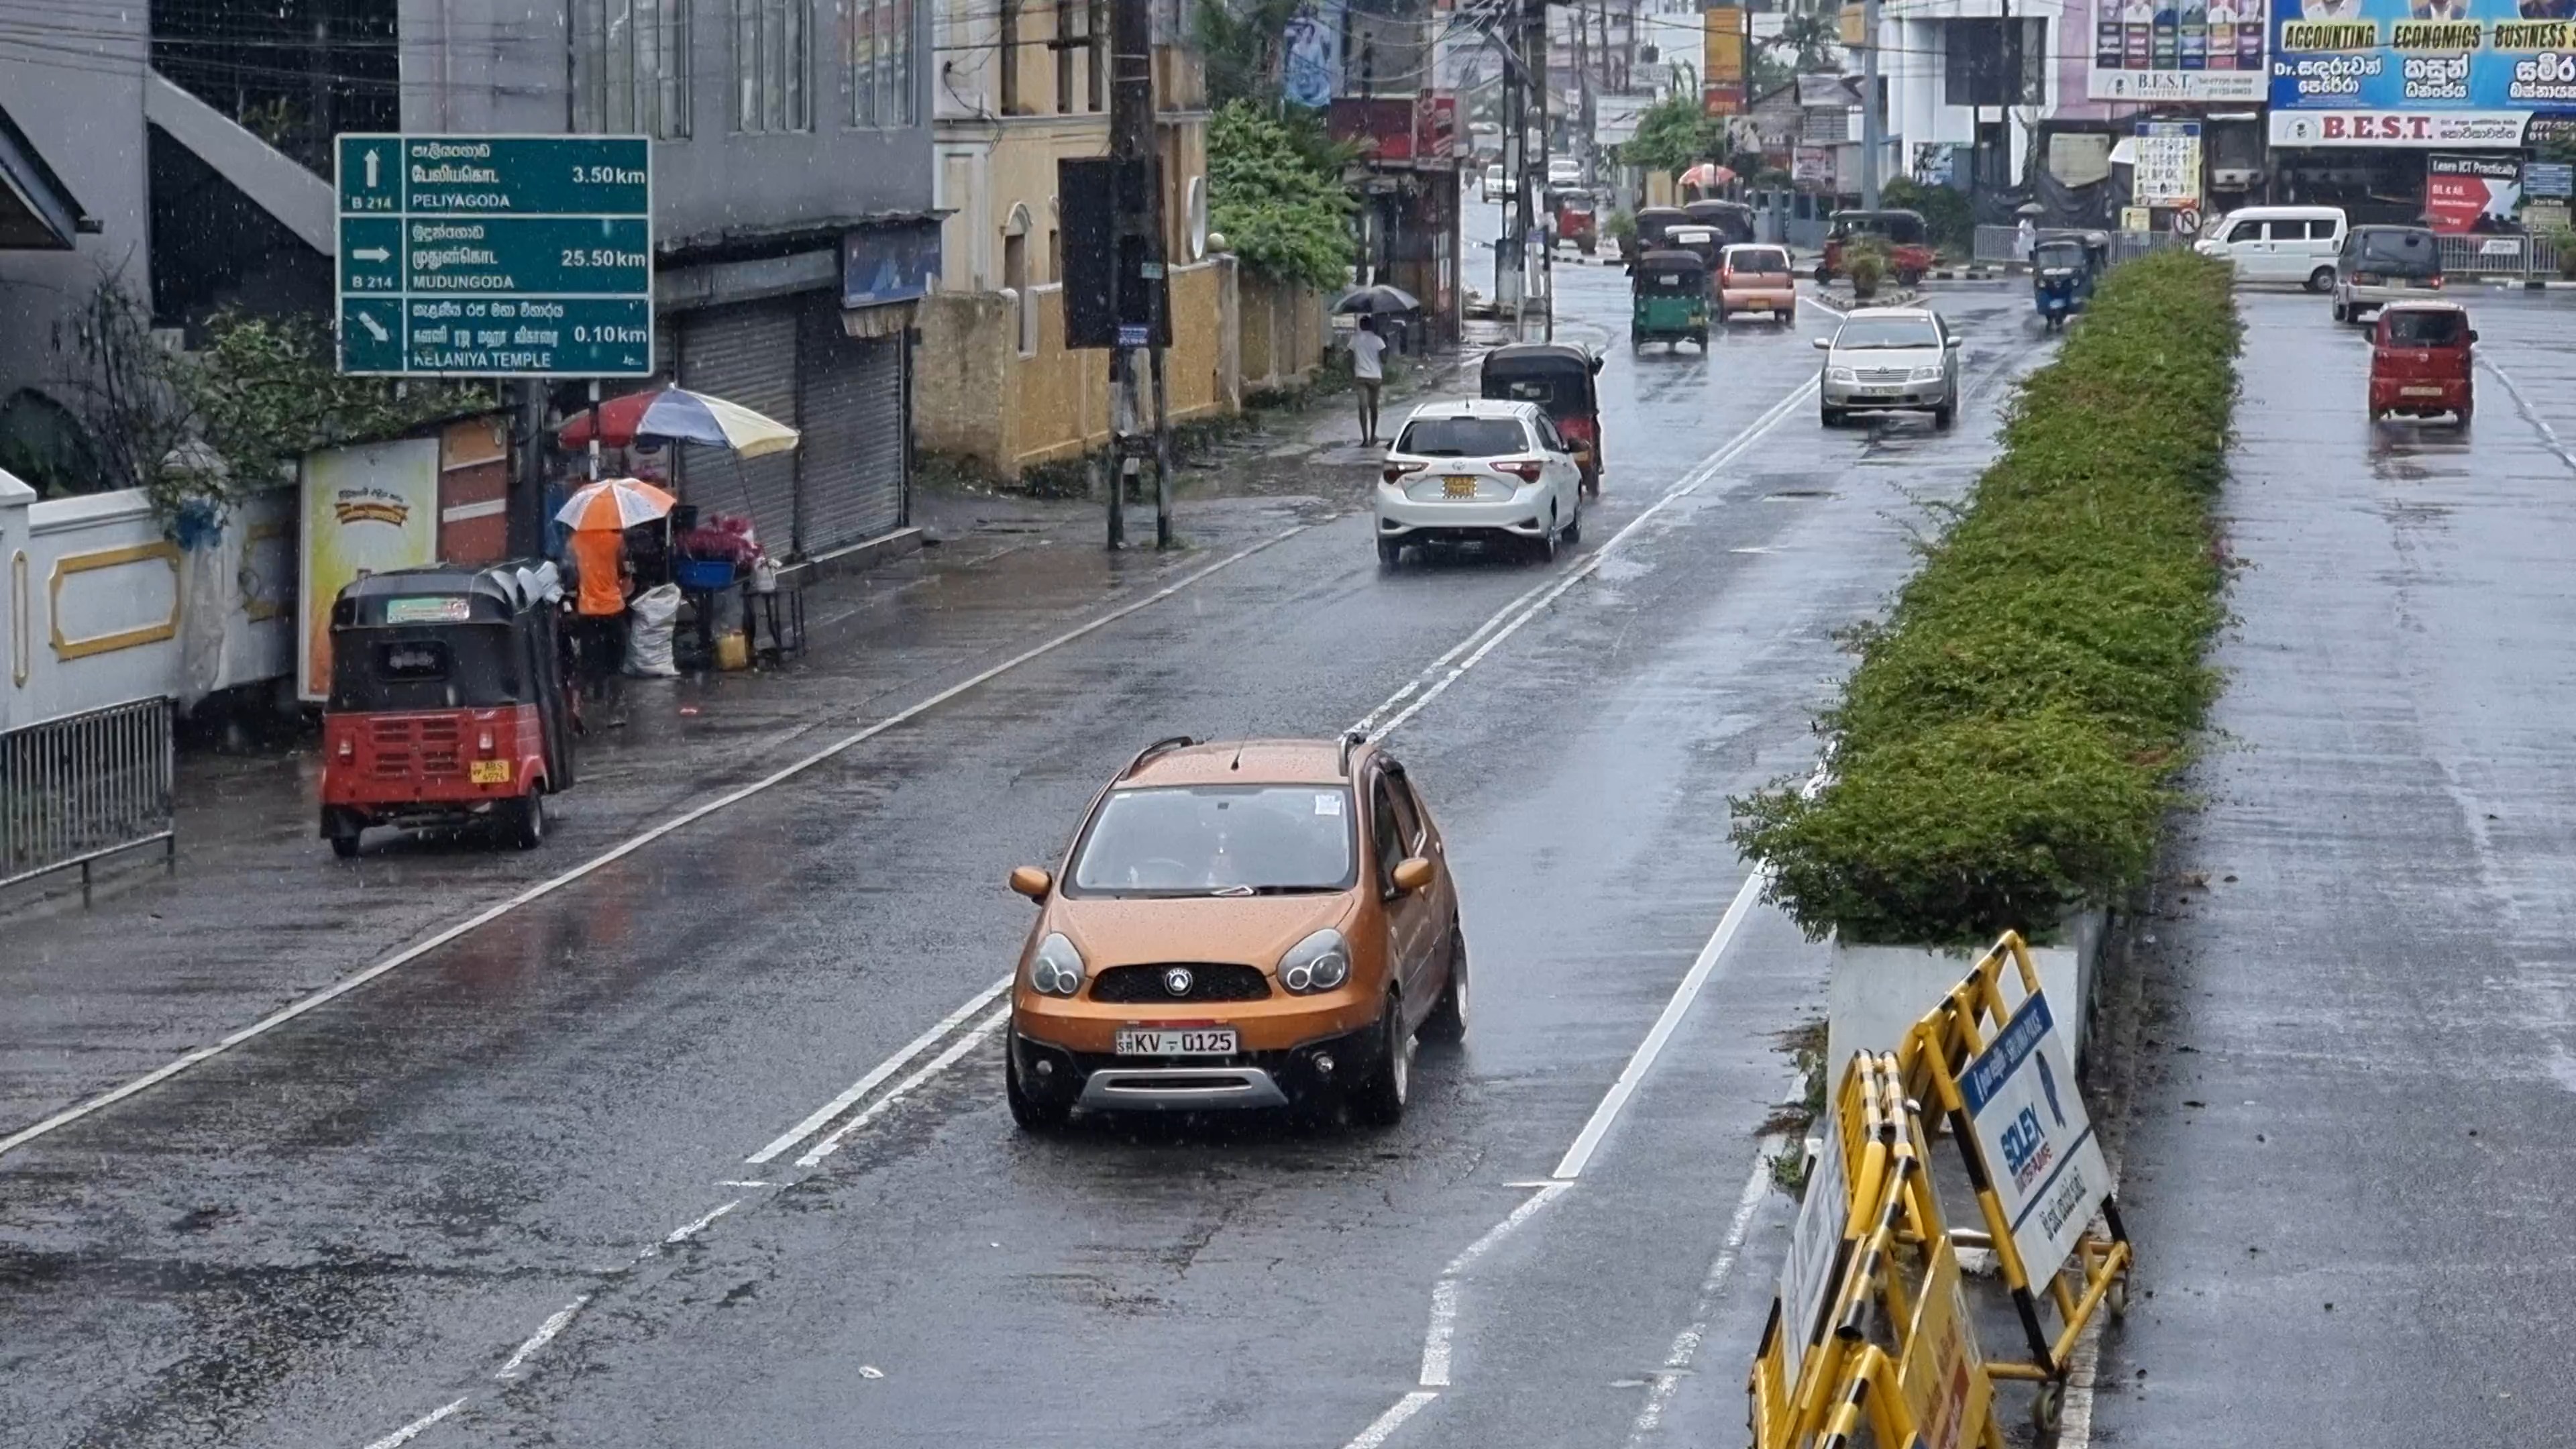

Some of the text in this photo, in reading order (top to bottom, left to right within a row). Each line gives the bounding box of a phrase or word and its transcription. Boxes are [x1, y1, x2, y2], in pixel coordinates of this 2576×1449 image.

[2285, 25, 2375, 48] ACCOUNTING
[2393, 25, 2481, 49] ECONOMICS
[2494, 25, 2567, 48] BUSINESS
[2323, 115, 2432, 139] B.E.S.T.
[2433, 160, 2457, 172] Learn
[352, 197, 392, 209] B 214
[412, 194, 511, 208] PELIYAGODA
[352, 276, 392, 288] B 214
[412, 276, 515, 288] MUDUNGODA
[413, 352, 551, 367] KELANIYA TEMPLE
[1135, 1034, 1161, 1053] KV
[1181, 1033, 1232, 1052] 0125
[2000, 1101, 2045, 1177] SOLEX
